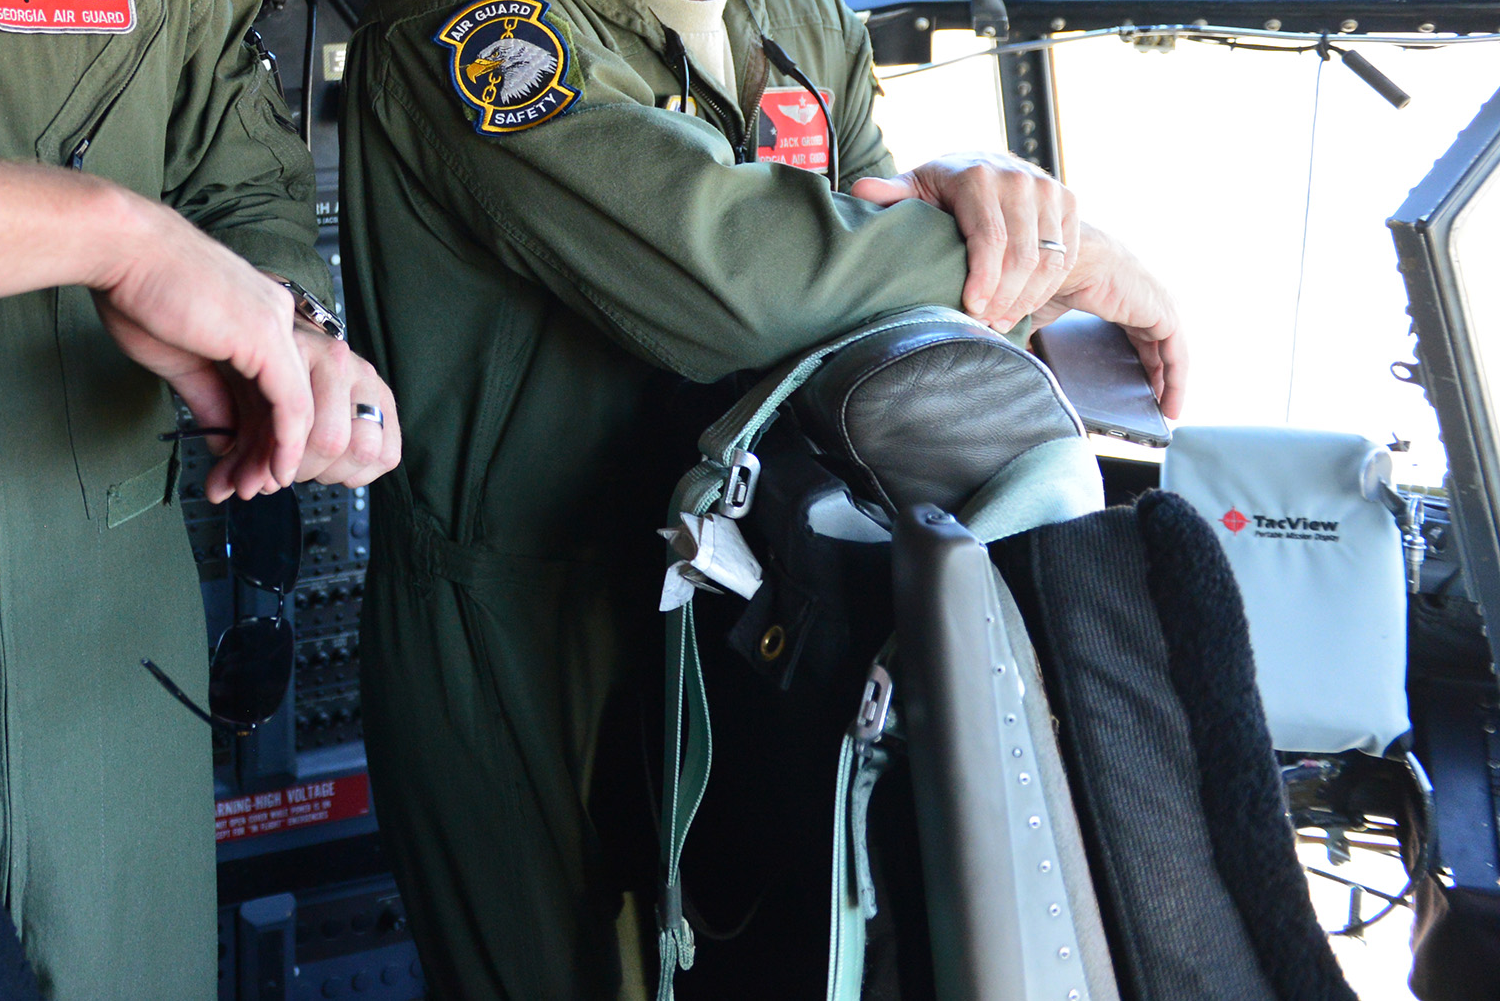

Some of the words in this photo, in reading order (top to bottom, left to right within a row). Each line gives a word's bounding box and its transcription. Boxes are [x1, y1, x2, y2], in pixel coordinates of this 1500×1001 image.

[53, 9, 76, 23] AIR
[82, 10, 125, 24] GUARD
[450, 19, 474, 42] AIR
[475, 3, 531, 21] GUARD
[494, 93, 558, 125] SAFETY
[779, 137, 800, 148] JACK
[760, 154, 787, 164] ORGIA
[791, 153, 806, 165] AIR
[1253, 515, 1339, 532] TacView
[286, 782, 336, 804] VOLTAGE
